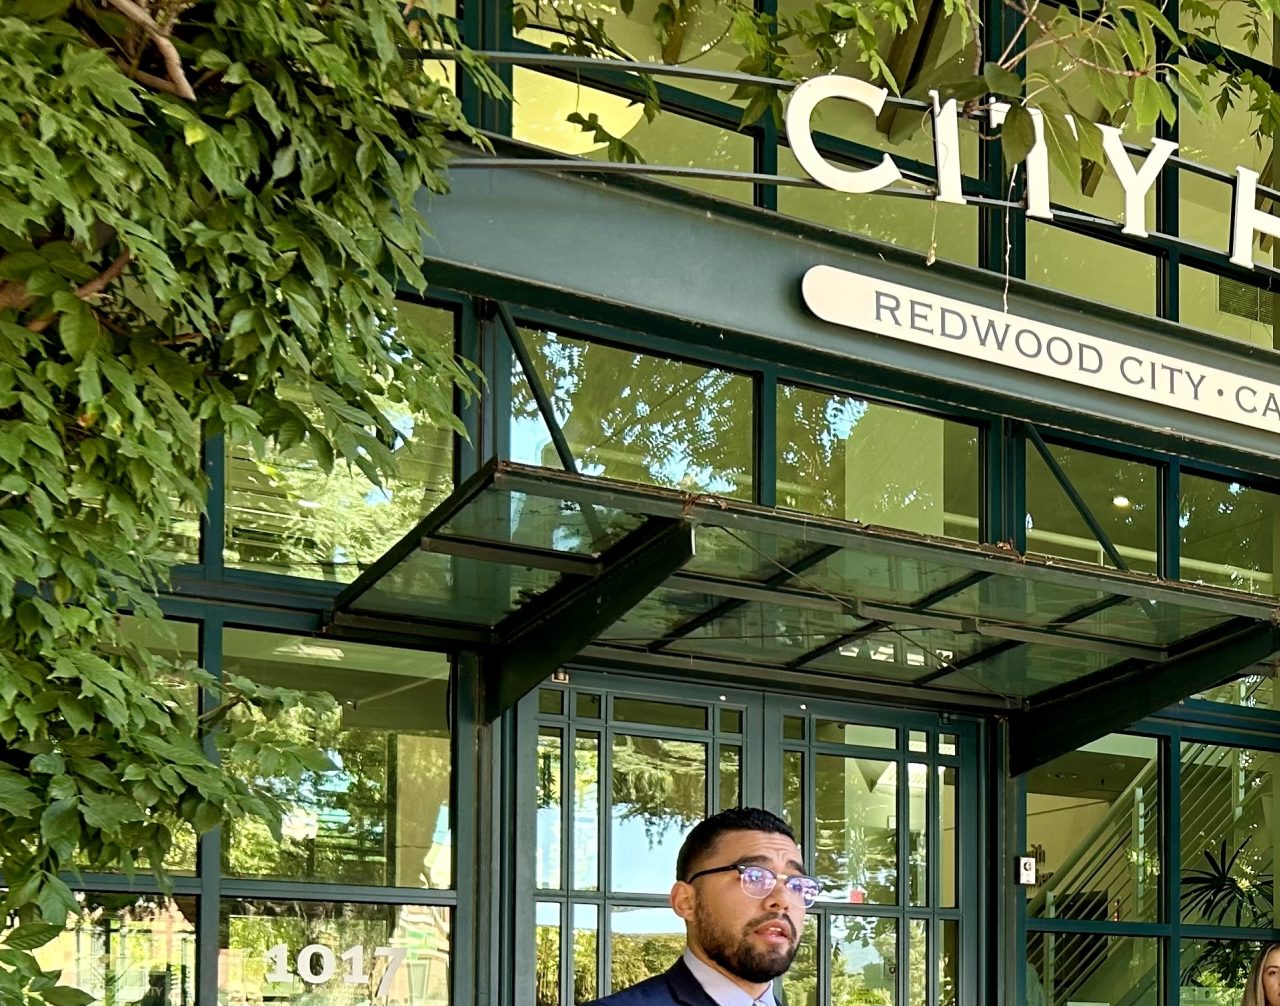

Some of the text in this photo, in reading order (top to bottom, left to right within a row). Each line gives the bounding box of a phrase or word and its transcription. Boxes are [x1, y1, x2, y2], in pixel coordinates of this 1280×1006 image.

[786, 75, 1179, 237] CITY
[875, 290, 1103, 374] REDWOOD
[1120, 356, 1206, 400] CITY
[265, 943, 408, 998] 1017
